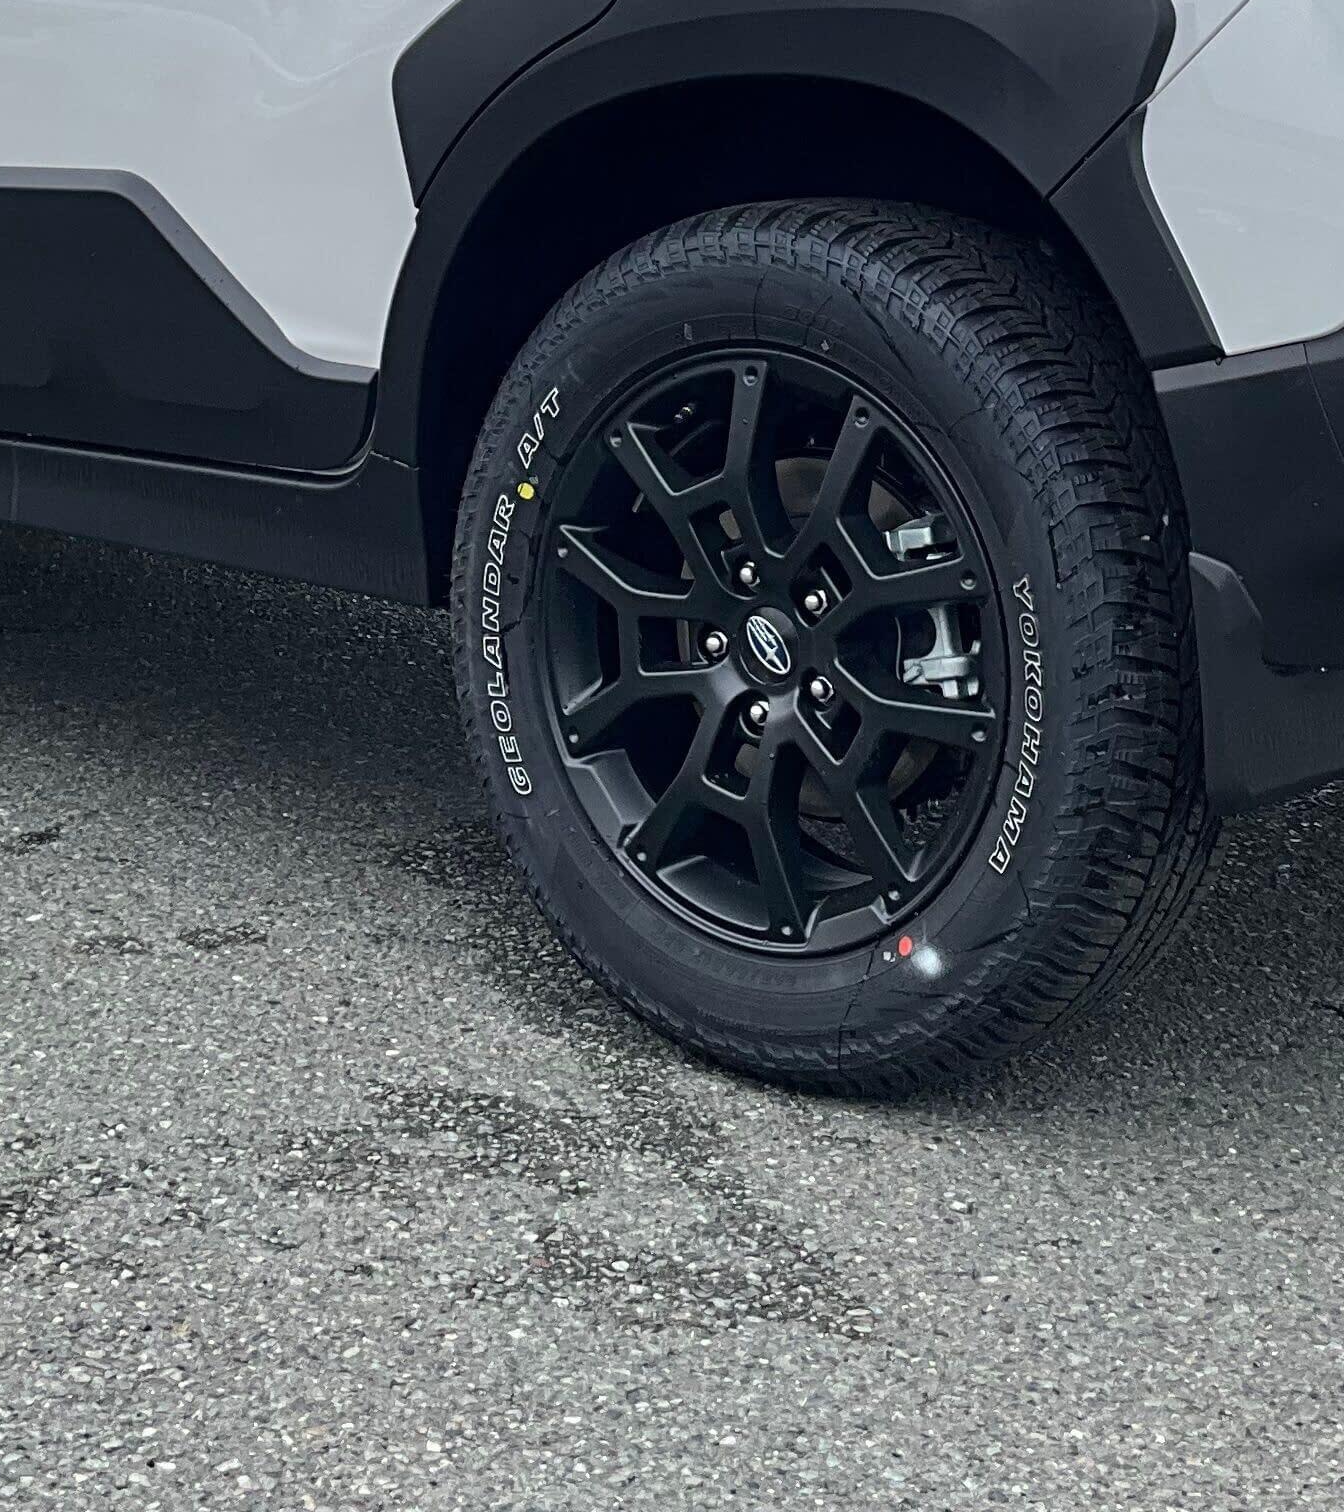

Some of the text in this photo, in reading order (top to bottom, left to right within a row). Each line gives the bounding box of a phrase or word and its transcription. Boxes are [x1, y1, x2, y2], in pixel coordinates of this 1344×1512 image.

[482, 386, 560, 796] GEOLANDAR A/T
[988, 576, 1044, 874] YOKOHAMA
